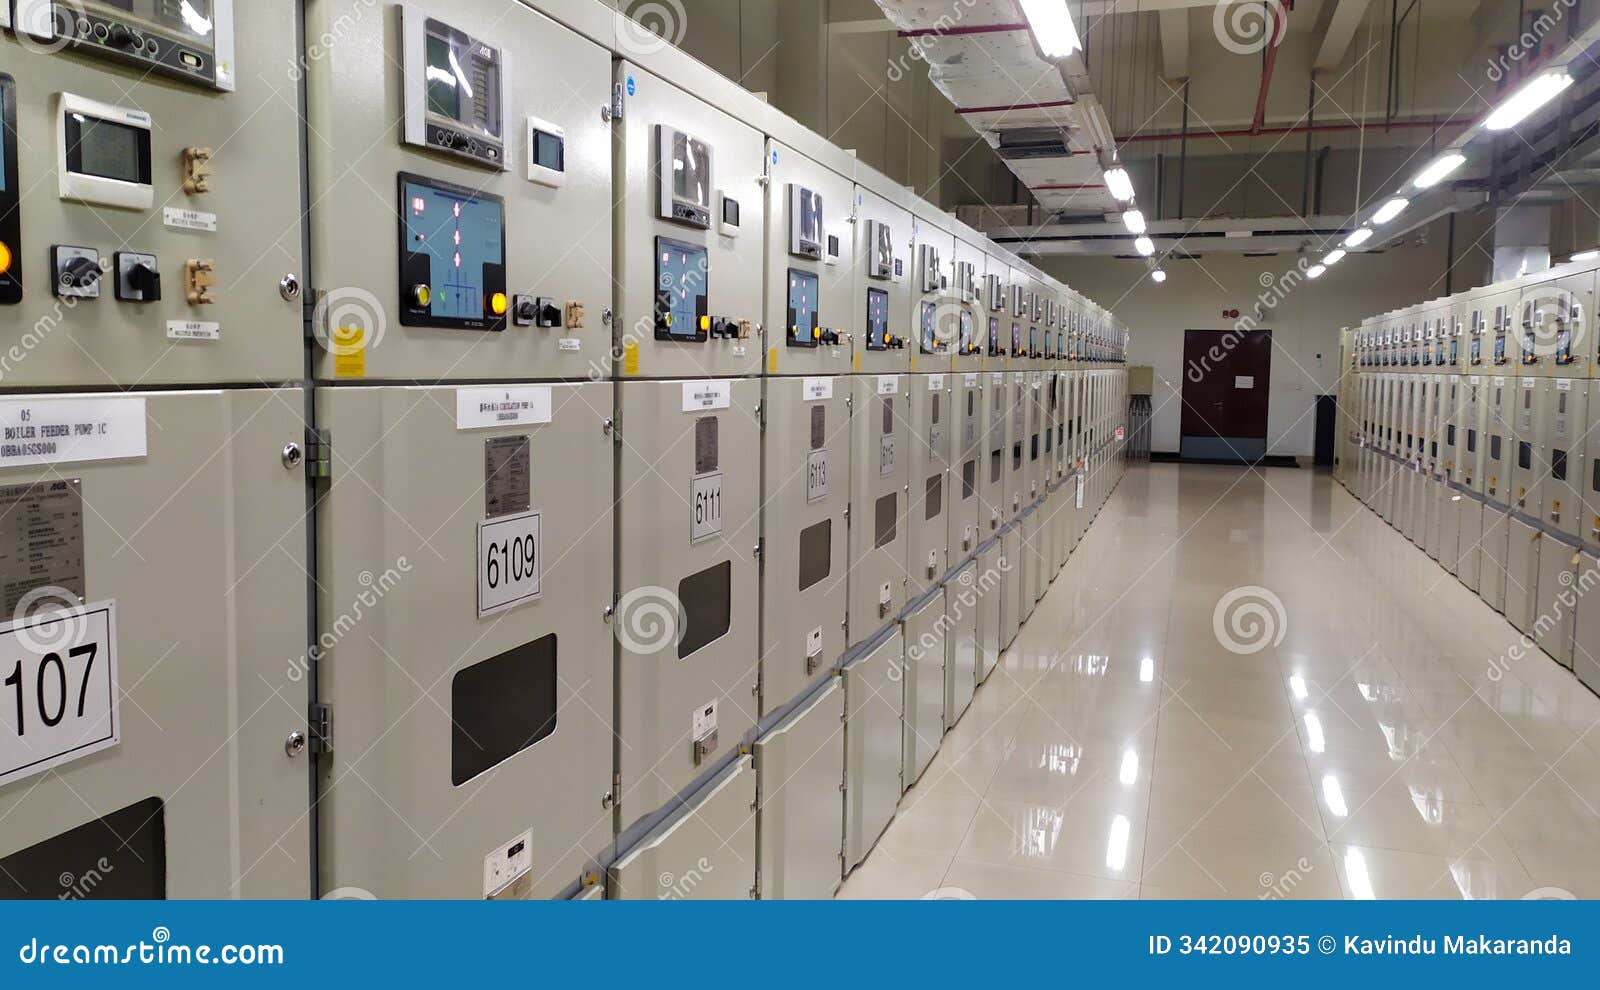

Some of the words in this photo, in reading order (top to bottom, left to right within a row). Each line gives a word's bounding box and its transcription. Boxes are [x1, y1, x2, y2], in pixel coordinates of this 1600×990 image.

[20, 408, 32, 422] 05
[5, 426, 36, 440] BOILER
[41, 424, 70, 438] FEEDER
[74, 423, 94, 436] PUMP
[810, 460, 826, 489] 6113
[695, 486, 721, 524] 6111
[487, 533, 536, 589] 6109
